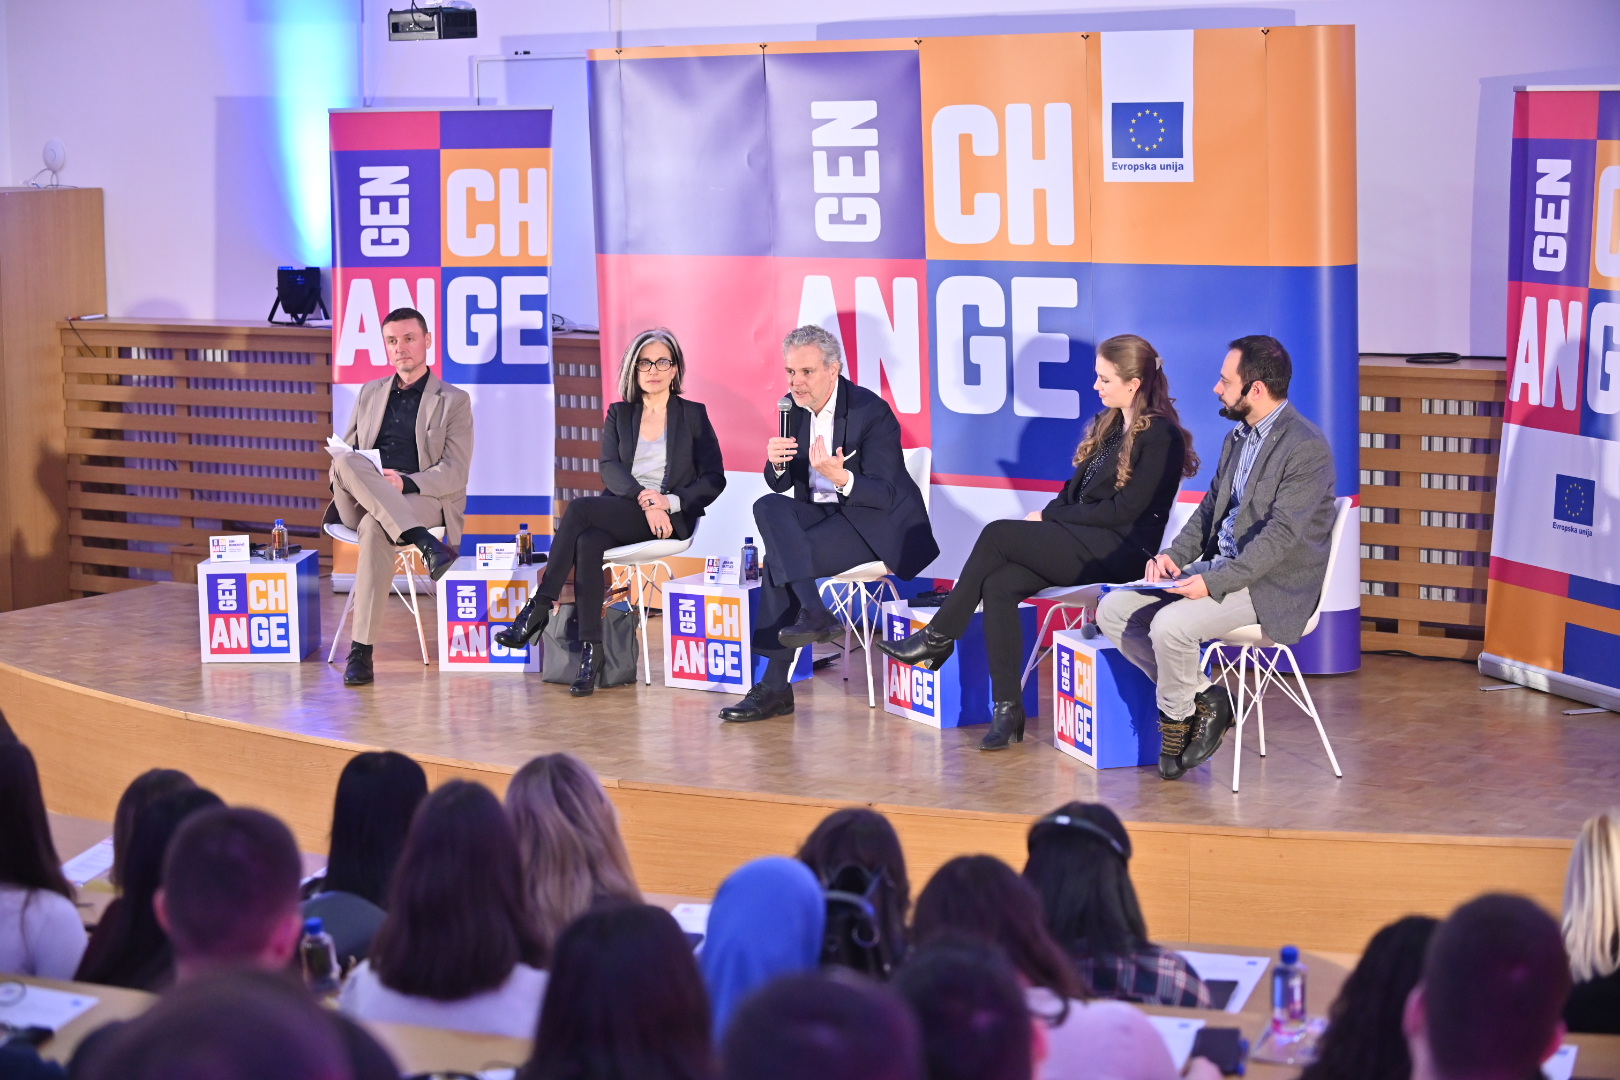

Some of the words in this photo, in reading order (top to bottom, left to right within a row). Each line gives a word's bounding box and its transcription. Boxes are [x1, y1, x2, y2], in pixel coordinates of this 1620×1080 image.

[811, 100, 881, 242] GEN
[931, 103, 1075, 246] CH
[1112, 161, 1157, 173] Evropska
[1160, 161, 1184, 173] unija
[359, 165, 410, 257] GEN
[446, 167, 548, 257] CH
[1532, 158, 1572, 272] GEN
[1595, 165, 1620, 277] C
[1509, 296, 1620, 415] ANG
[1552, 521, 1578, 534] Evropska
[1578, 528, 1593, 538] unija
[217, 578, 238, 611] GEN
[249, 579, 287, 611] CH
[457, 585, 477, 619] GEN
[489, 586, 527, 619] CH
[211, 616, 289, 649] ANGE
[678, 598, 697, 634] GEN
[706, 602, 740, 638] CH
[672, 639, 742, 678] ANGE
[1060, 651, 1071, 692] GEN
[889, 663, 934, 710] ANGE
[1075, 659, 1092, 703] CH
[1057, 696, 1092, 748] ANGE
